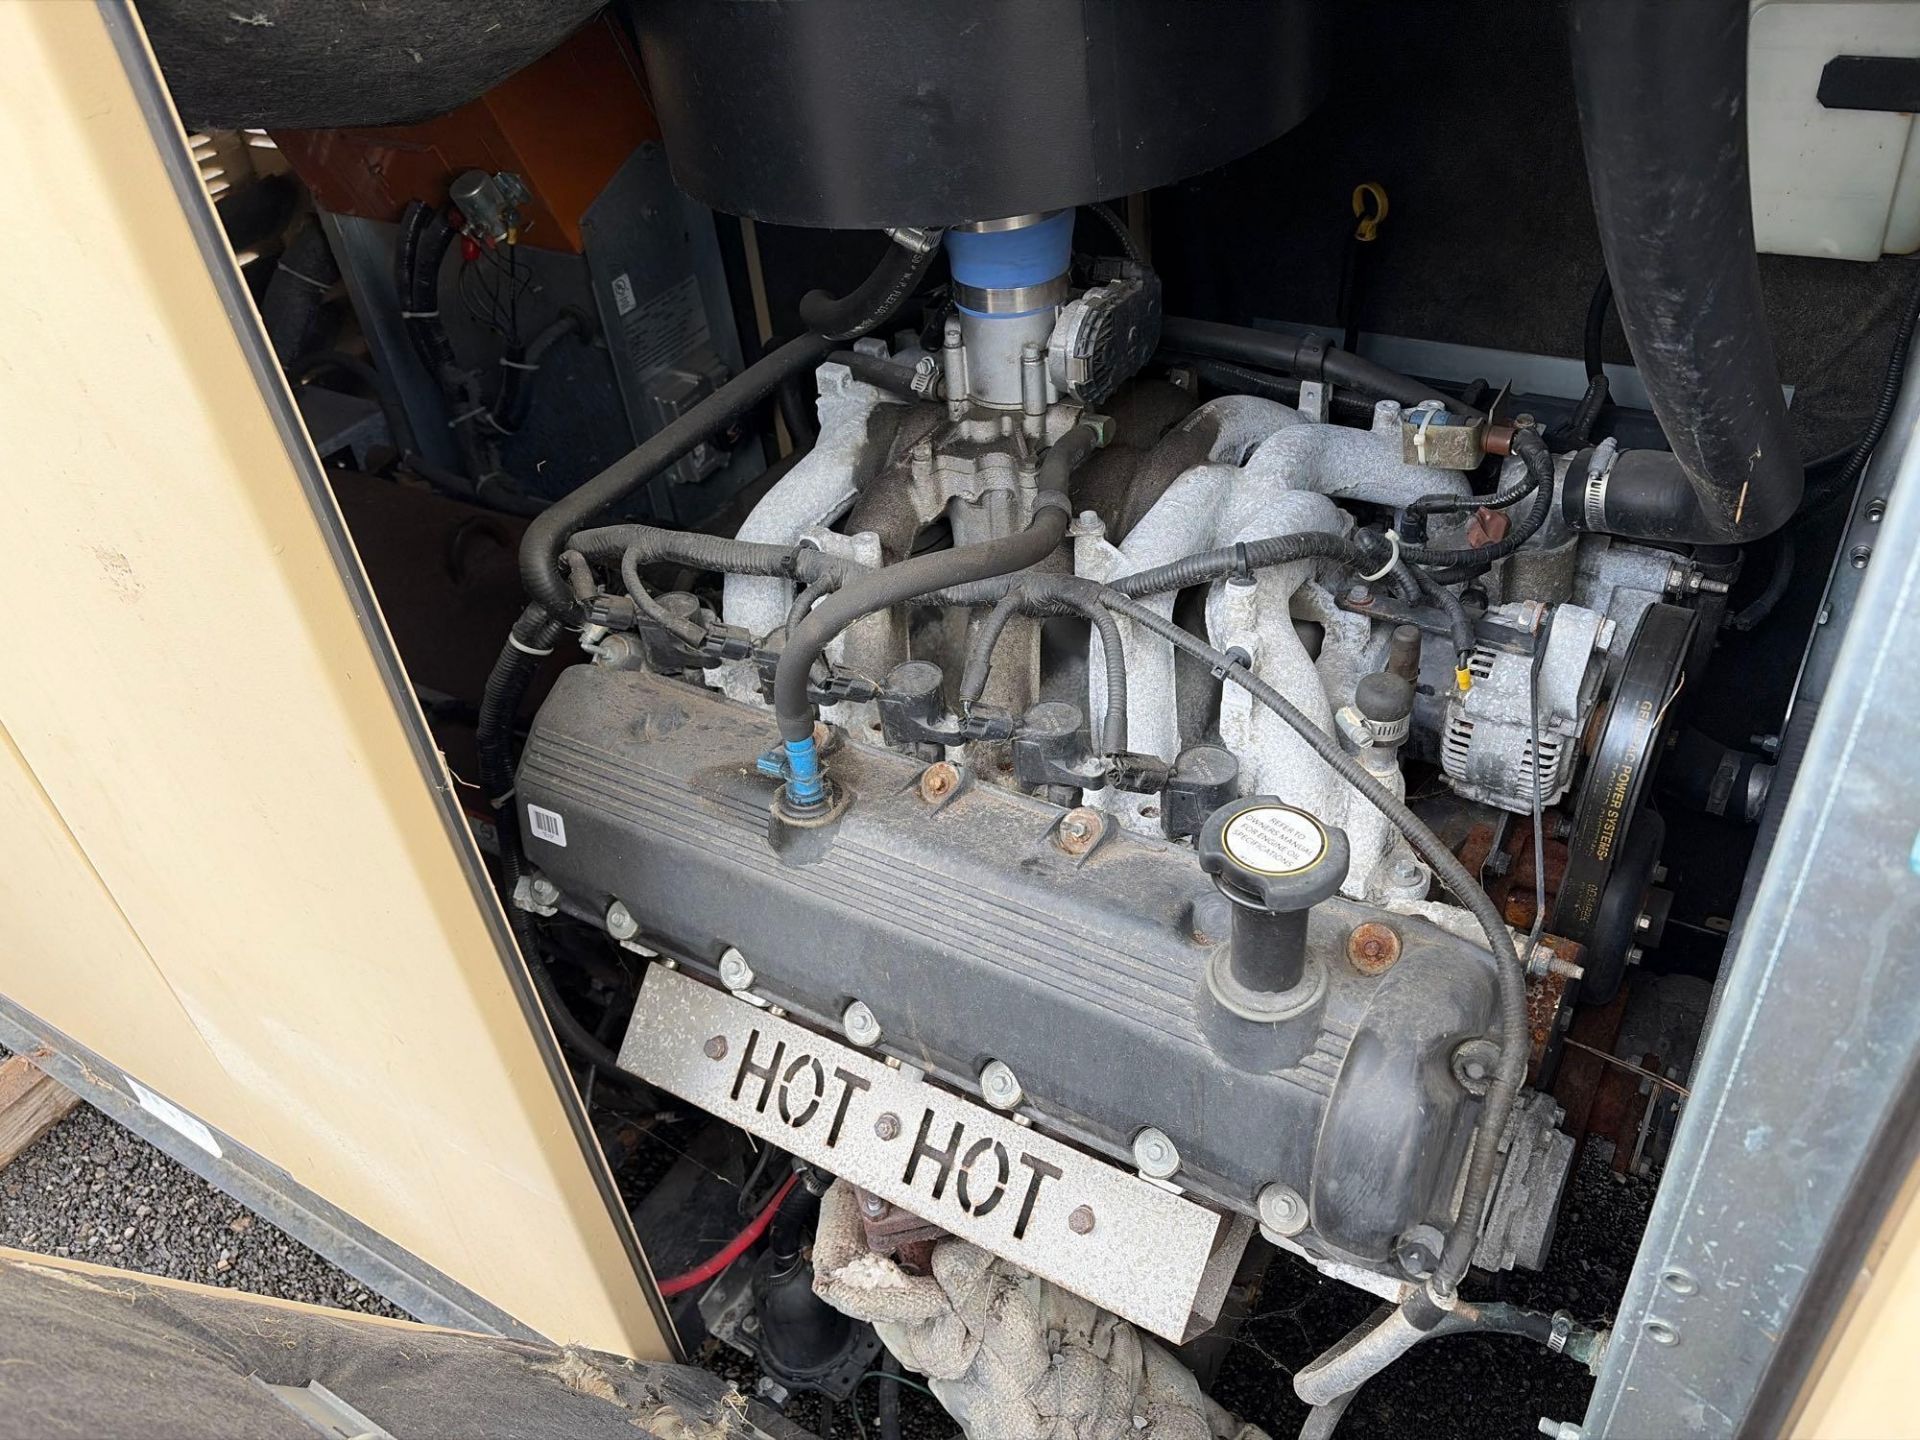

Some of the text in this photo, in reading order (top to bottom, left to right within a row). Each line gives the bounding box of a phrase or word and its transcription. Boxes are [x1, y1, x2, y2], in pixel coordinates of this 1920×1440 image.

[1627, 701, 1653, 766] GENAC
[1613, 764, 1633, 808] POWER
[1232, 829, 1294, 867] SPECIFICATIONS
[1241, 823, 1300, 860] FOR ENGINE OIL
[1270, 817, 1307, 840] REFER TO
[1279, 834, 1312, 856] MANUAL
[1597, 808, 1619, 859] SYSTEMS
[731, 1028, 1062, 1240] HOT HOT
